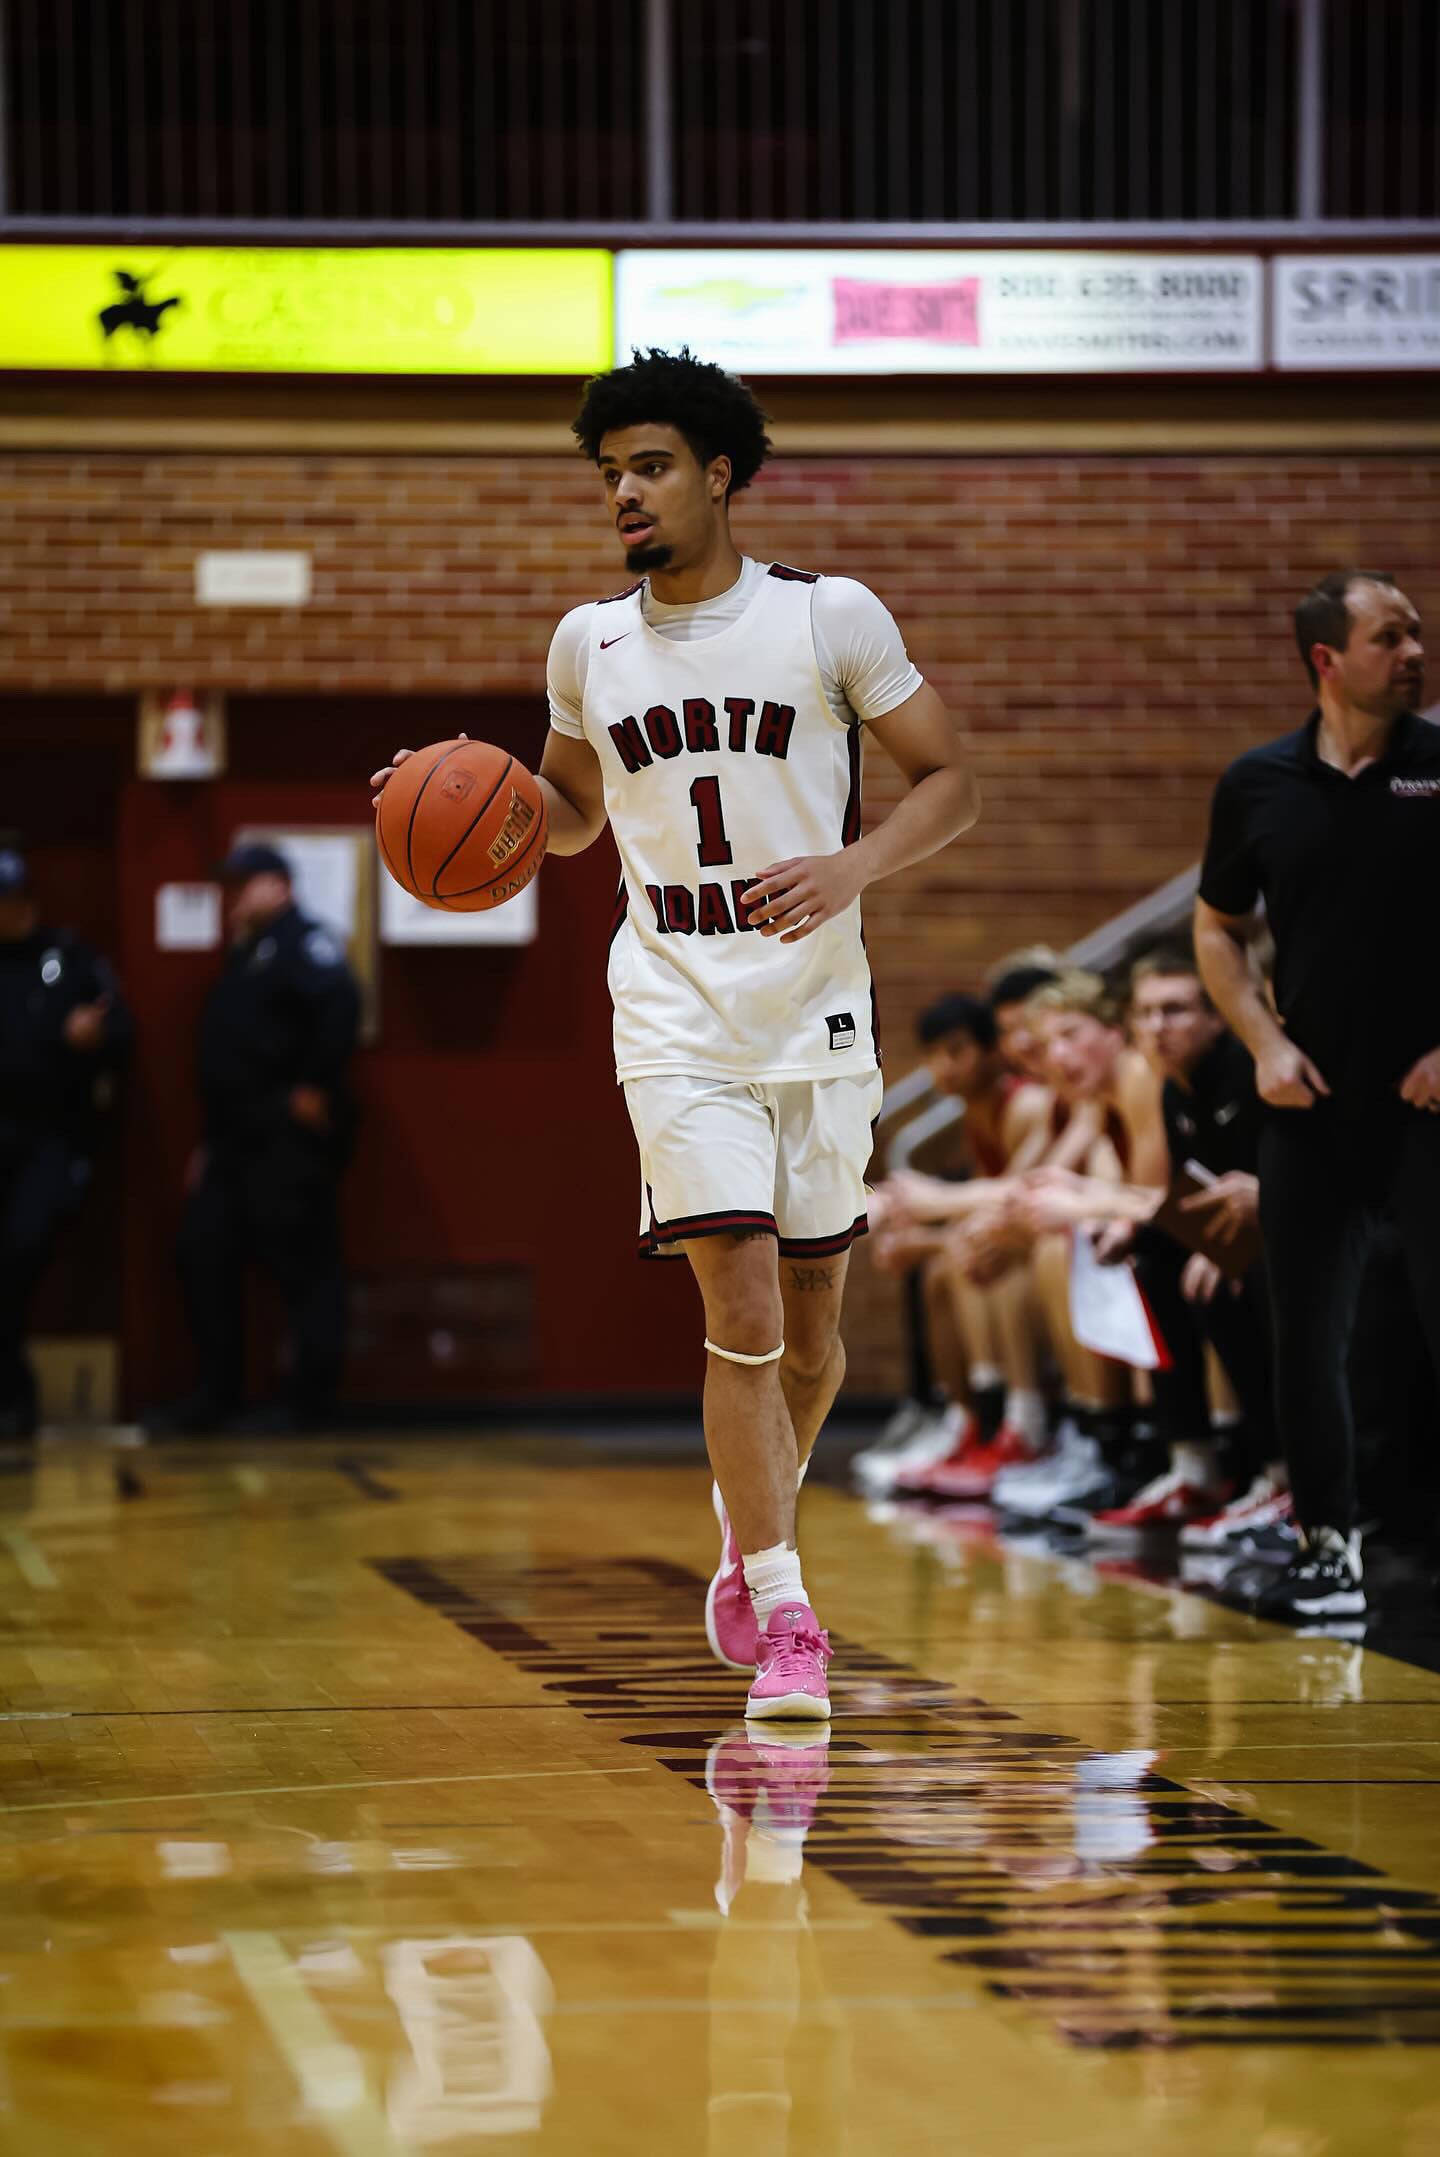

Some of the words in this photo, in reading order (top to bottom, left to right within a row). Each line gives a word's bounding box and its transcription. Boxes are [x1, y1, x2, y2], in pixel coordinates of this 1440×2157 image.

[607, 696, 796, 774] NORTH
[689, 775, 733, 867] 1
[838, 1017, 847, 1028] L
